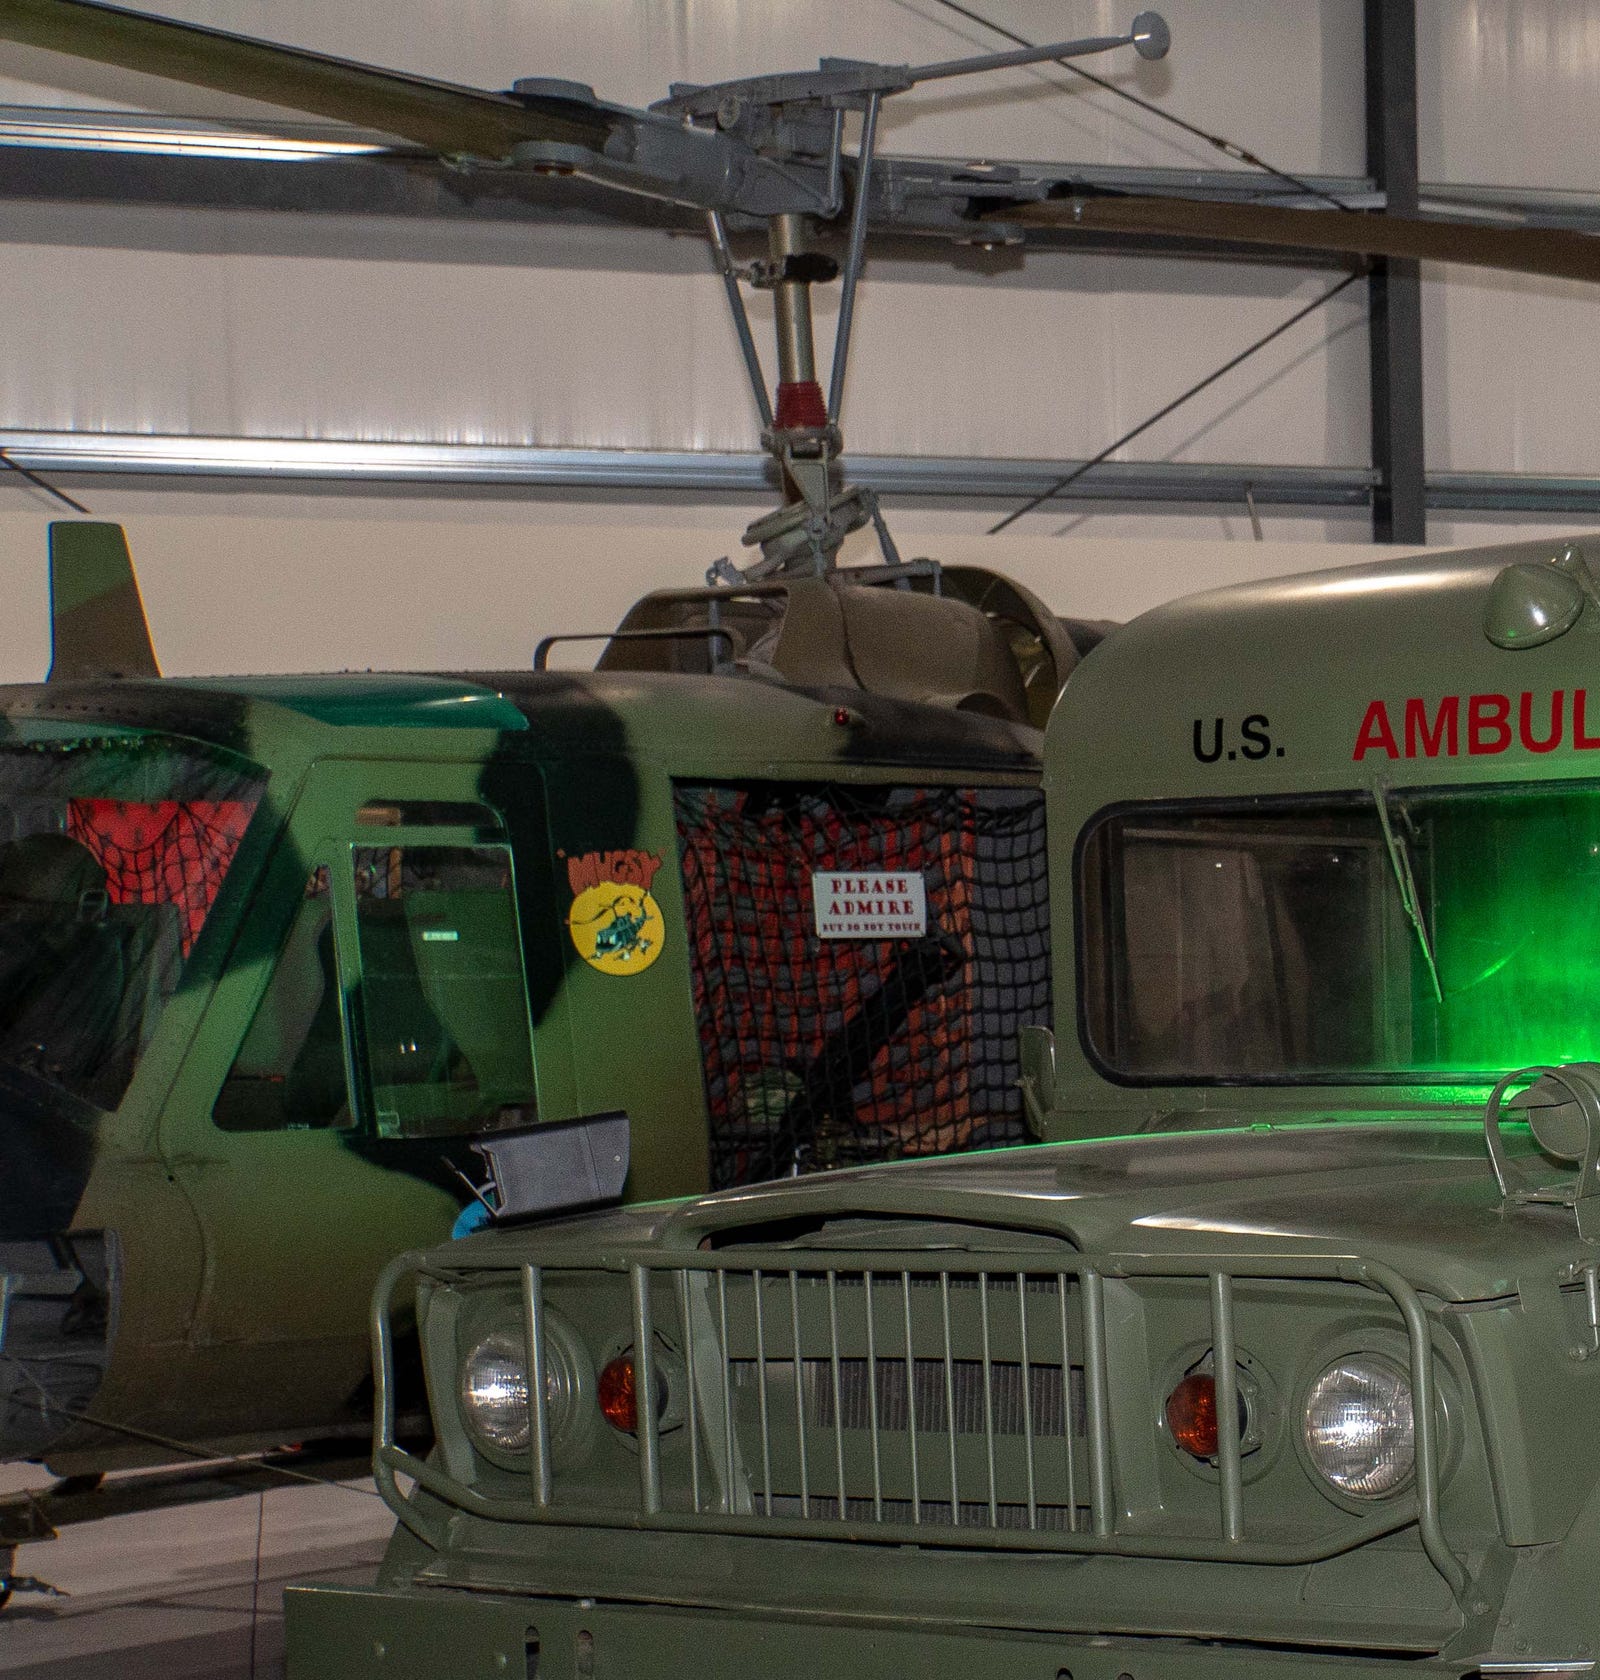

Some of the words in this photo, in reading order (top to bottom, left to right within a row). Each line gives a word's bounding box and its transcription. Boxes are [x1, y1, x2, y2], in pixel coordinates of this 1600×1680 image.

[1192, 715, 1286, 762] U.S.
[831, 878, 908, 894] PLEASE
[829, 900, 914, 915] ADMIRE
[823, 923, 842, 932] BUT
[847, 923, 860, 931] DO
[864, 923, 884, 931] NOT
[888, 923, 920, 931] TOUCH
